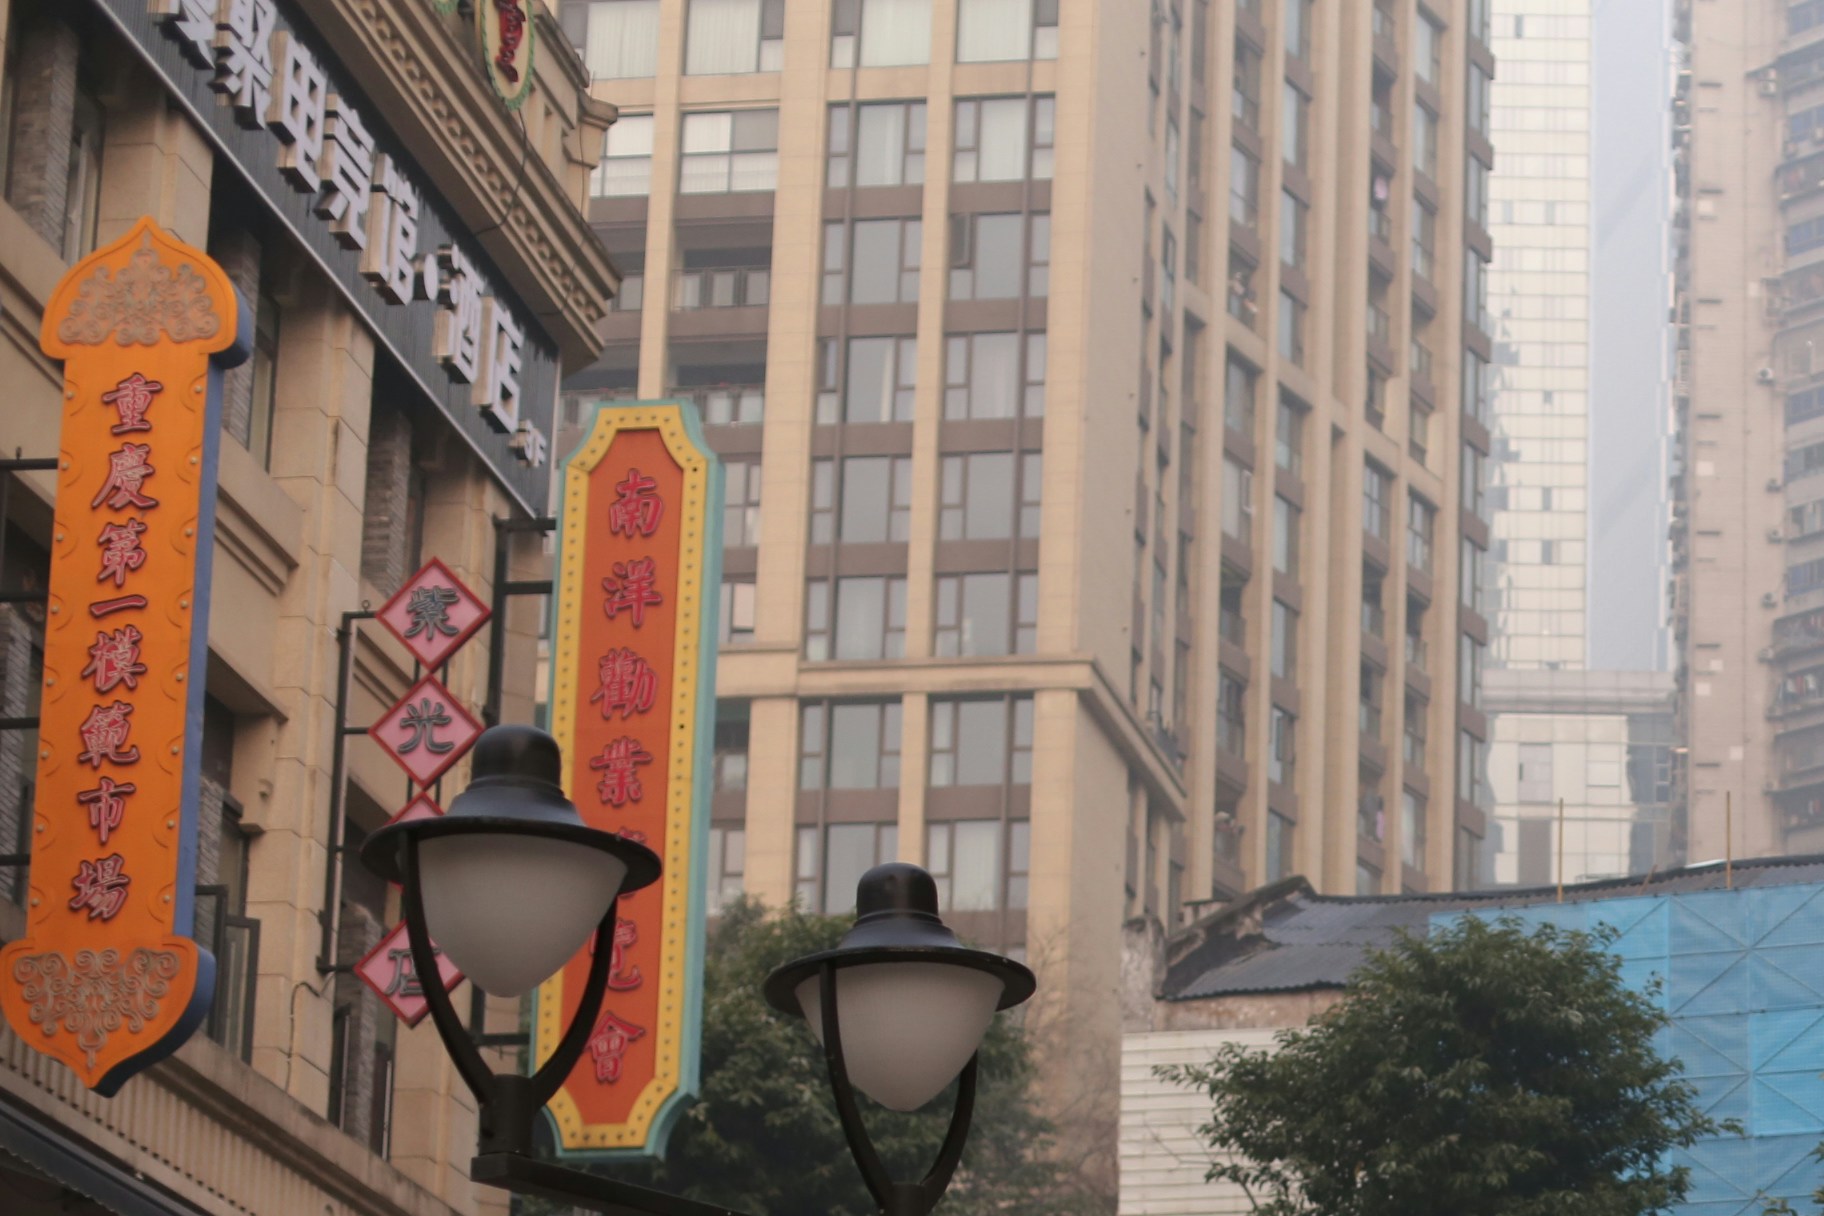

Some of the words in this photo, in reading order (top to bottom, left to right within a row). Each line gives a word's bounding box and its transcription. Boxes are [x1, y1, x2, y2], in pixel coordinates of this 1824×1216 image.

[68, 372, 164, 922] 重慶第一模範市場
